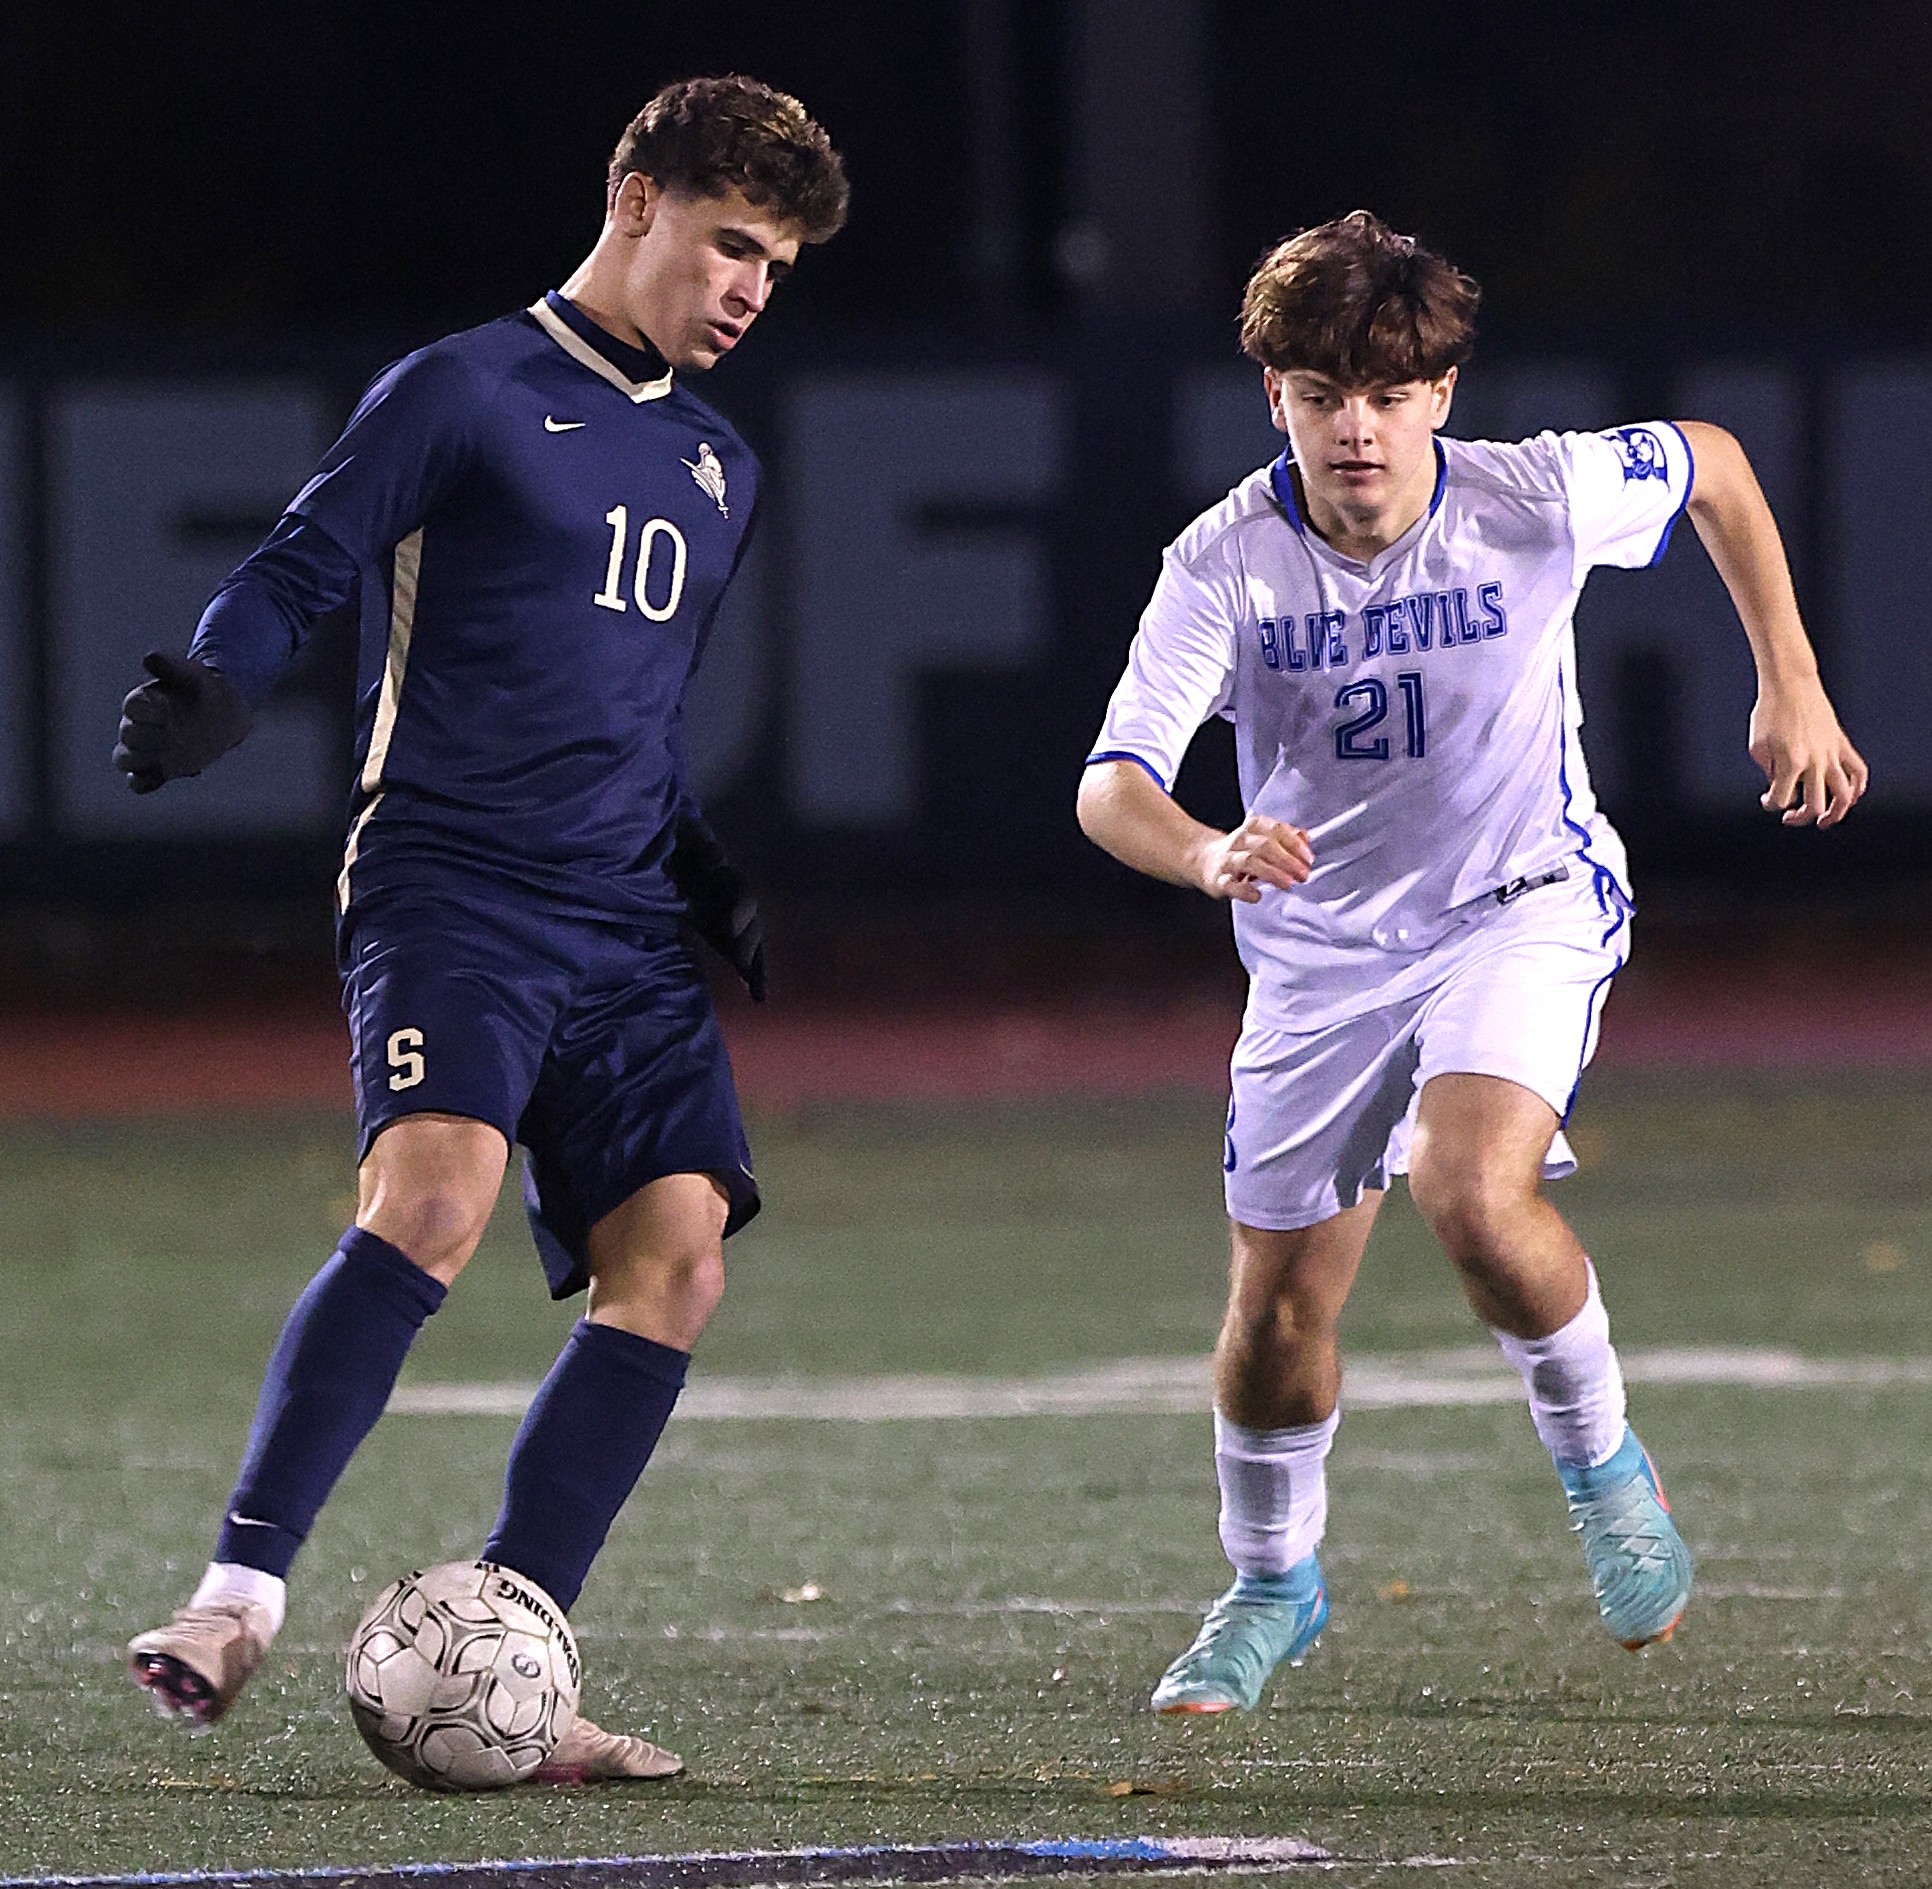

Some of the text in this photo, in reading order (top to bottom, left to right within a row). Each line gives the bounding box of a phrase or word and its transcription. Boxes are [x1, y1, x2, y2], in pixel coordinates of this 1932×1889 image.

[594, 504, 687, 622] 10
[1361, 581, 1507, 661] DEVILS
[1334, 670, 1426, 760] 21
[387, 1027, 425, 1091] S
